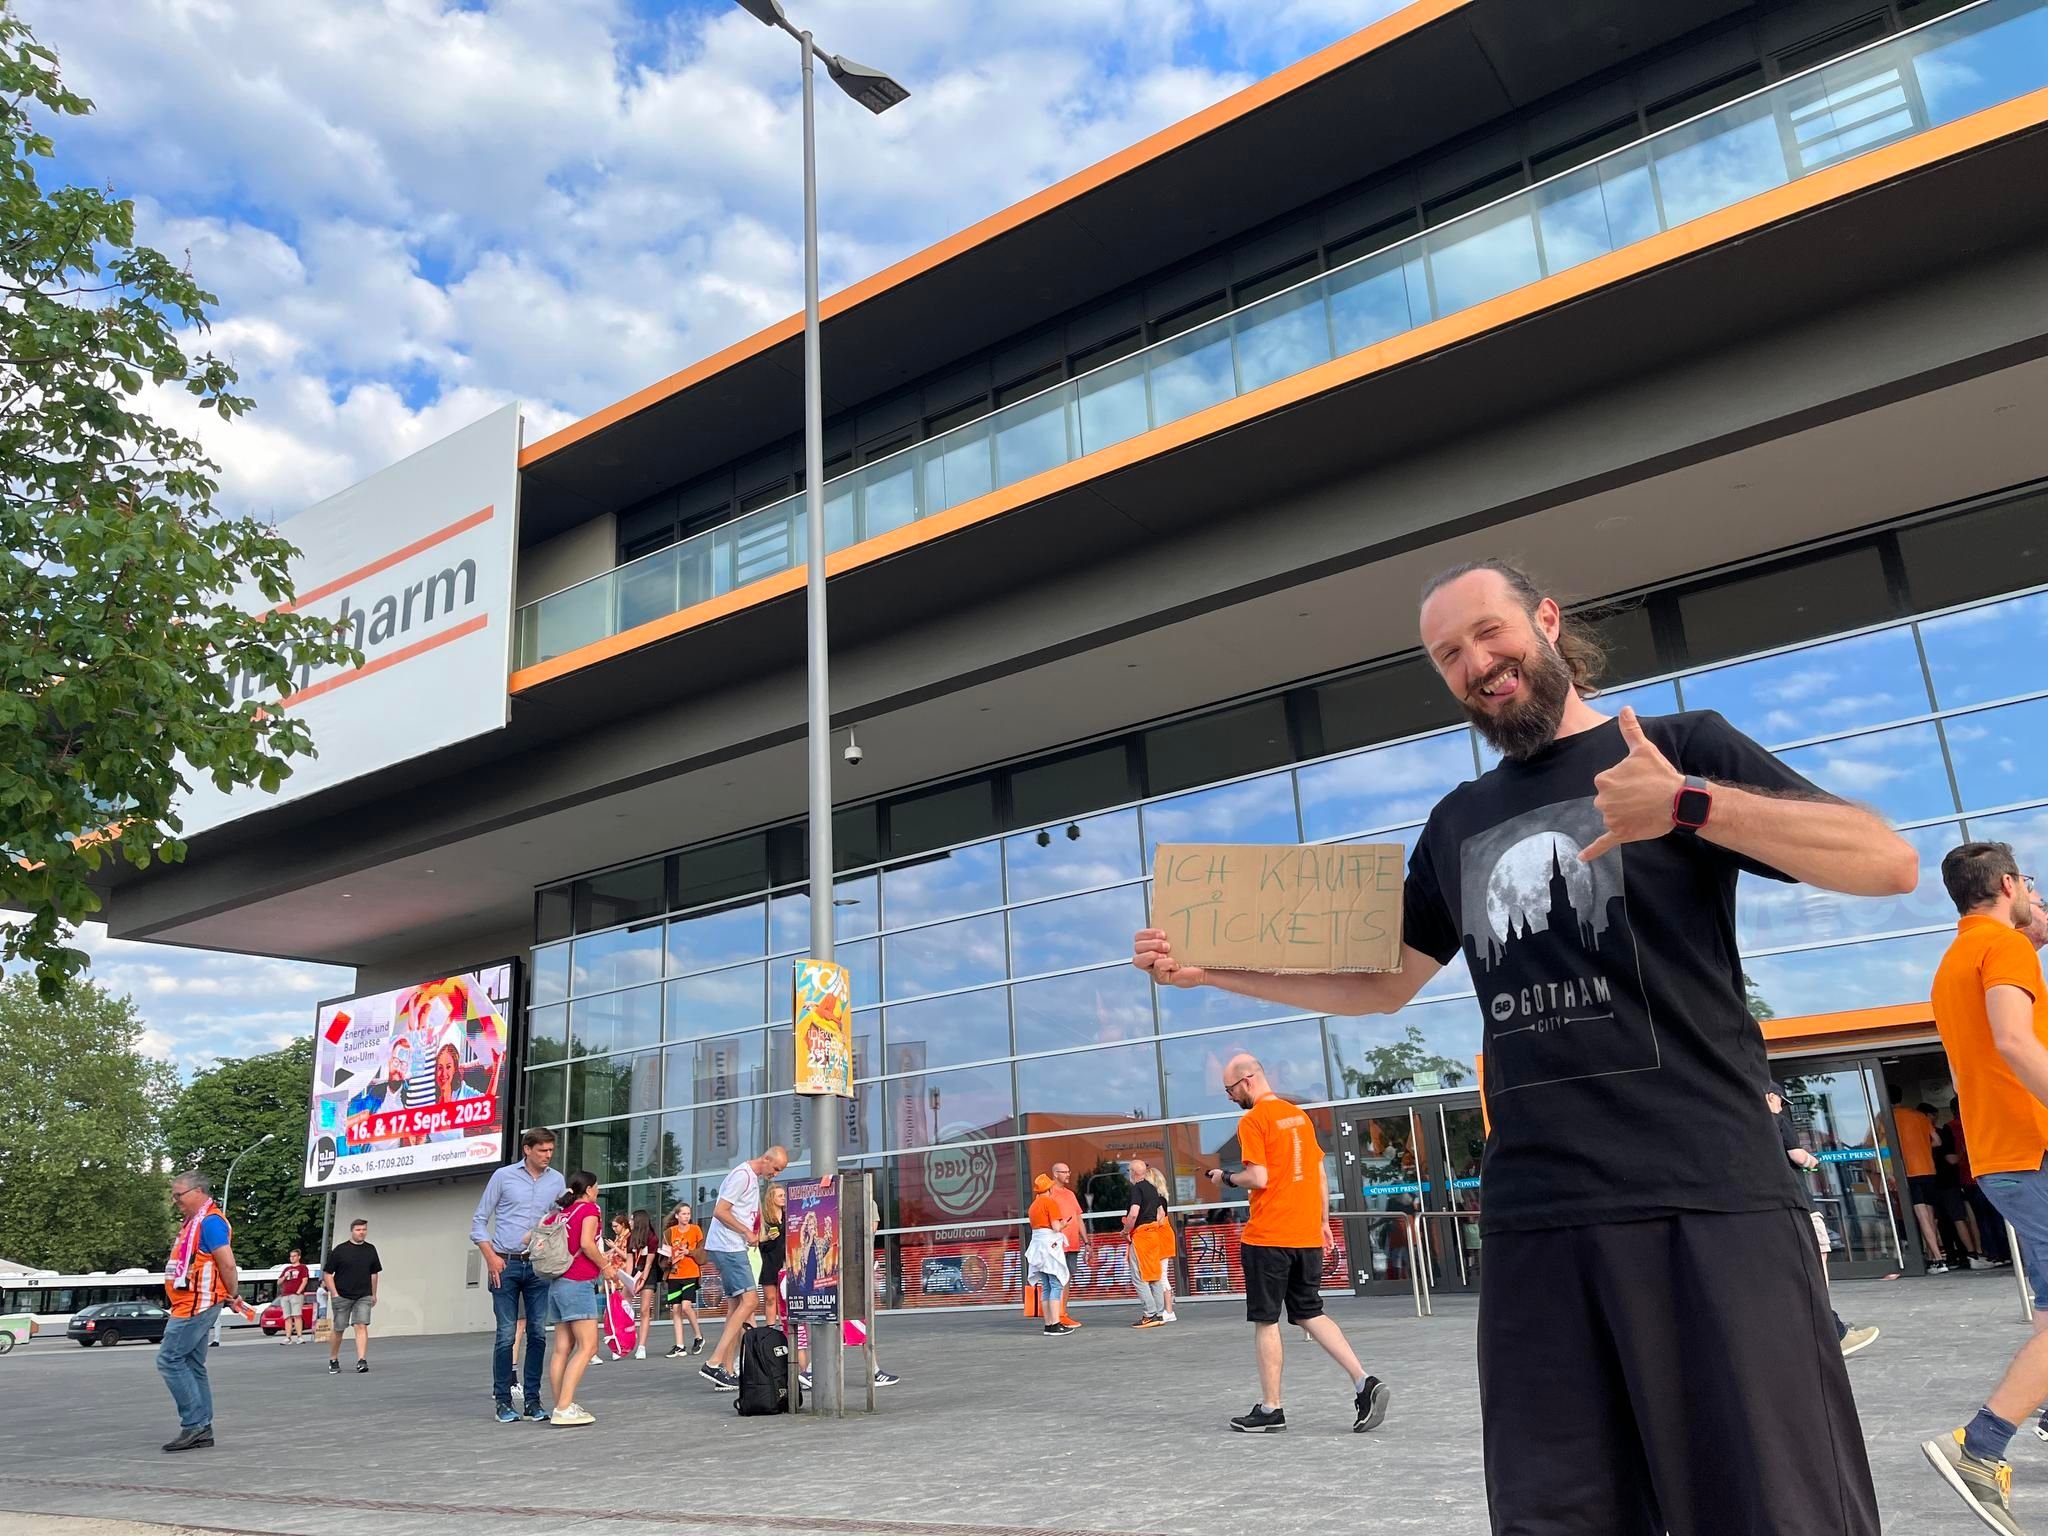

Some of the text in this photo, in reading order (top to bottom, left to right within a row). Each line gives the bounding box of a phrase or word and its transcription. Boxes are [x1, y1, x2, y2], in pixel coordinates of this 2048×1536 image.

[1166, 848, 1401, 892] ICH KAUFE
[1169, 890, 1387, 950] TICKETS
[1520, 976, 1612, 1016] GOTHAM
[345, 1020, 390, 1040] Energie- und
[1537, 1015, 1562, 1033] CITY
[344, 1038, 381, 1053] Baumesse
[343, 1051, 375, 1065] Neu-Ulm
[352, 1100, 492, 1140] 16. & 17. Sept. 2023
[432, 1147, 488, 1163] ratiopharm arena
[933, 1159, 967, 1181] BBU
[1453, 1179, 1481, 1189] SÜDWES
[807, 1295, 836, 1305] NEU-ULM
